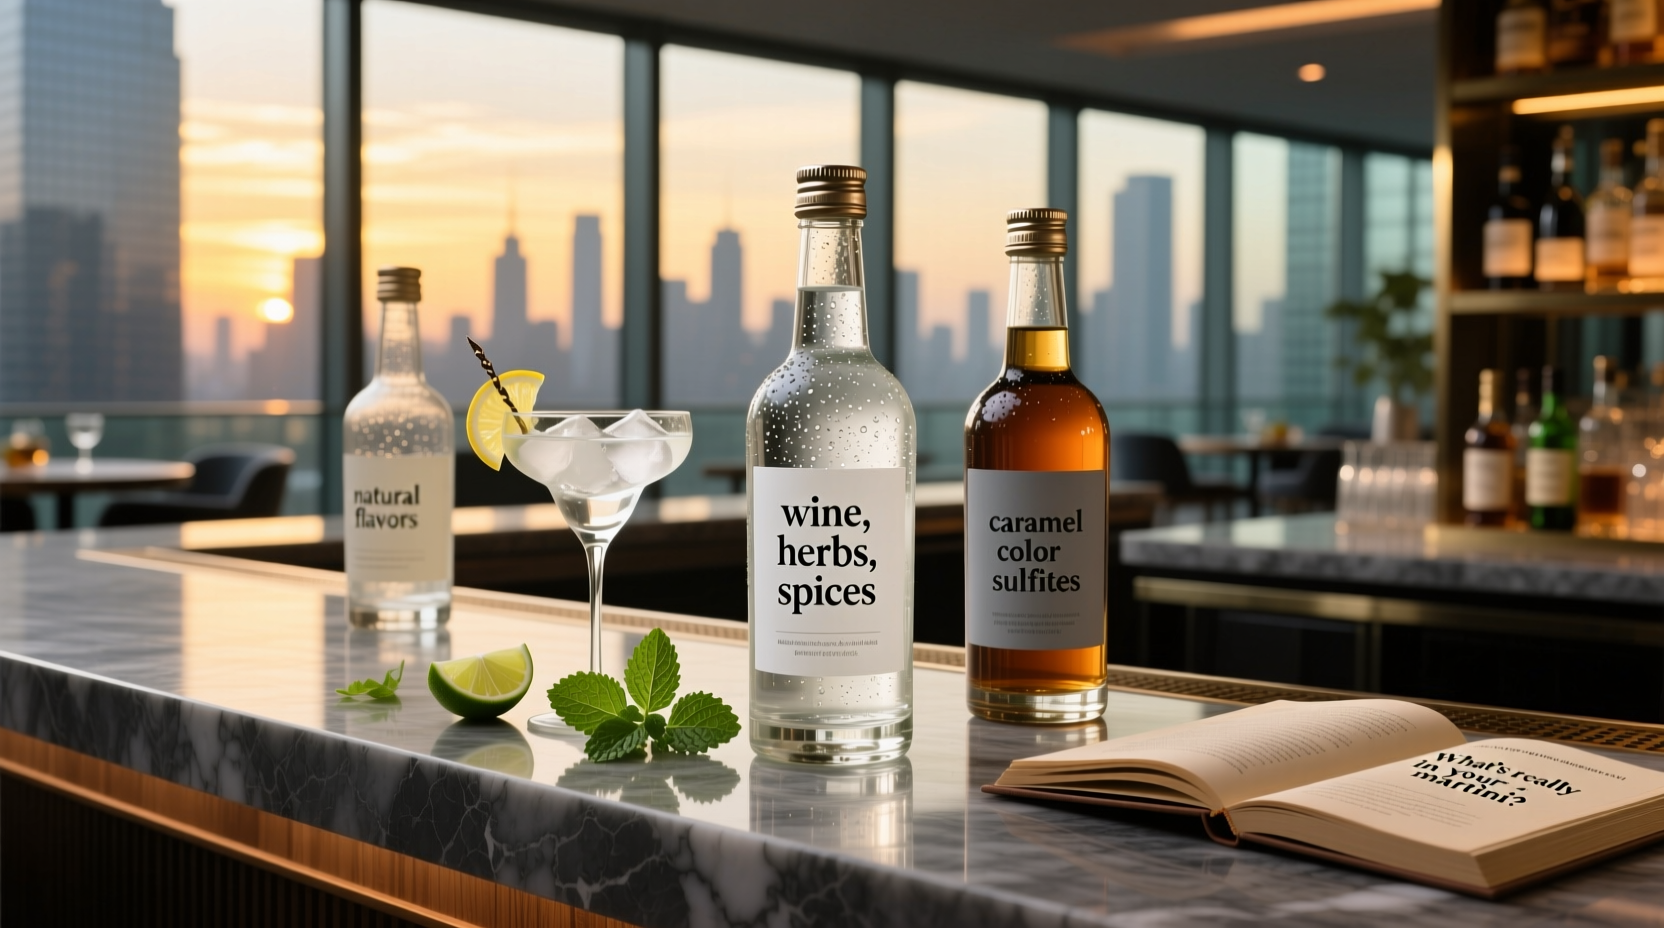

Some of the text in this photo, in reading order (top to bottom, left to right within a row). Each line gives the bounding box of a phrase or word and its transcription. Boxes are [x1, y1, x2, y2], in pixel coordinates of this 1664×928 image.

[353, 484, 420, 505] natural
[355, 507, 418, 529] flavors
[781, 495, 871, 534] wine,
[989, 508, 1083, 533] caramel
[777, 534, 877, 573] herbs,
[997, 538, 1061, 562] color
[992, 567, 1081, 592] sulfites
[778, 574, 876, 615] spices
[1436, 752, 1511, 775] What's
[1510, 770, 1581, 796] really
[1441, 767, 1509, 787] your
[1410, 771, 1527, 807] martini?
